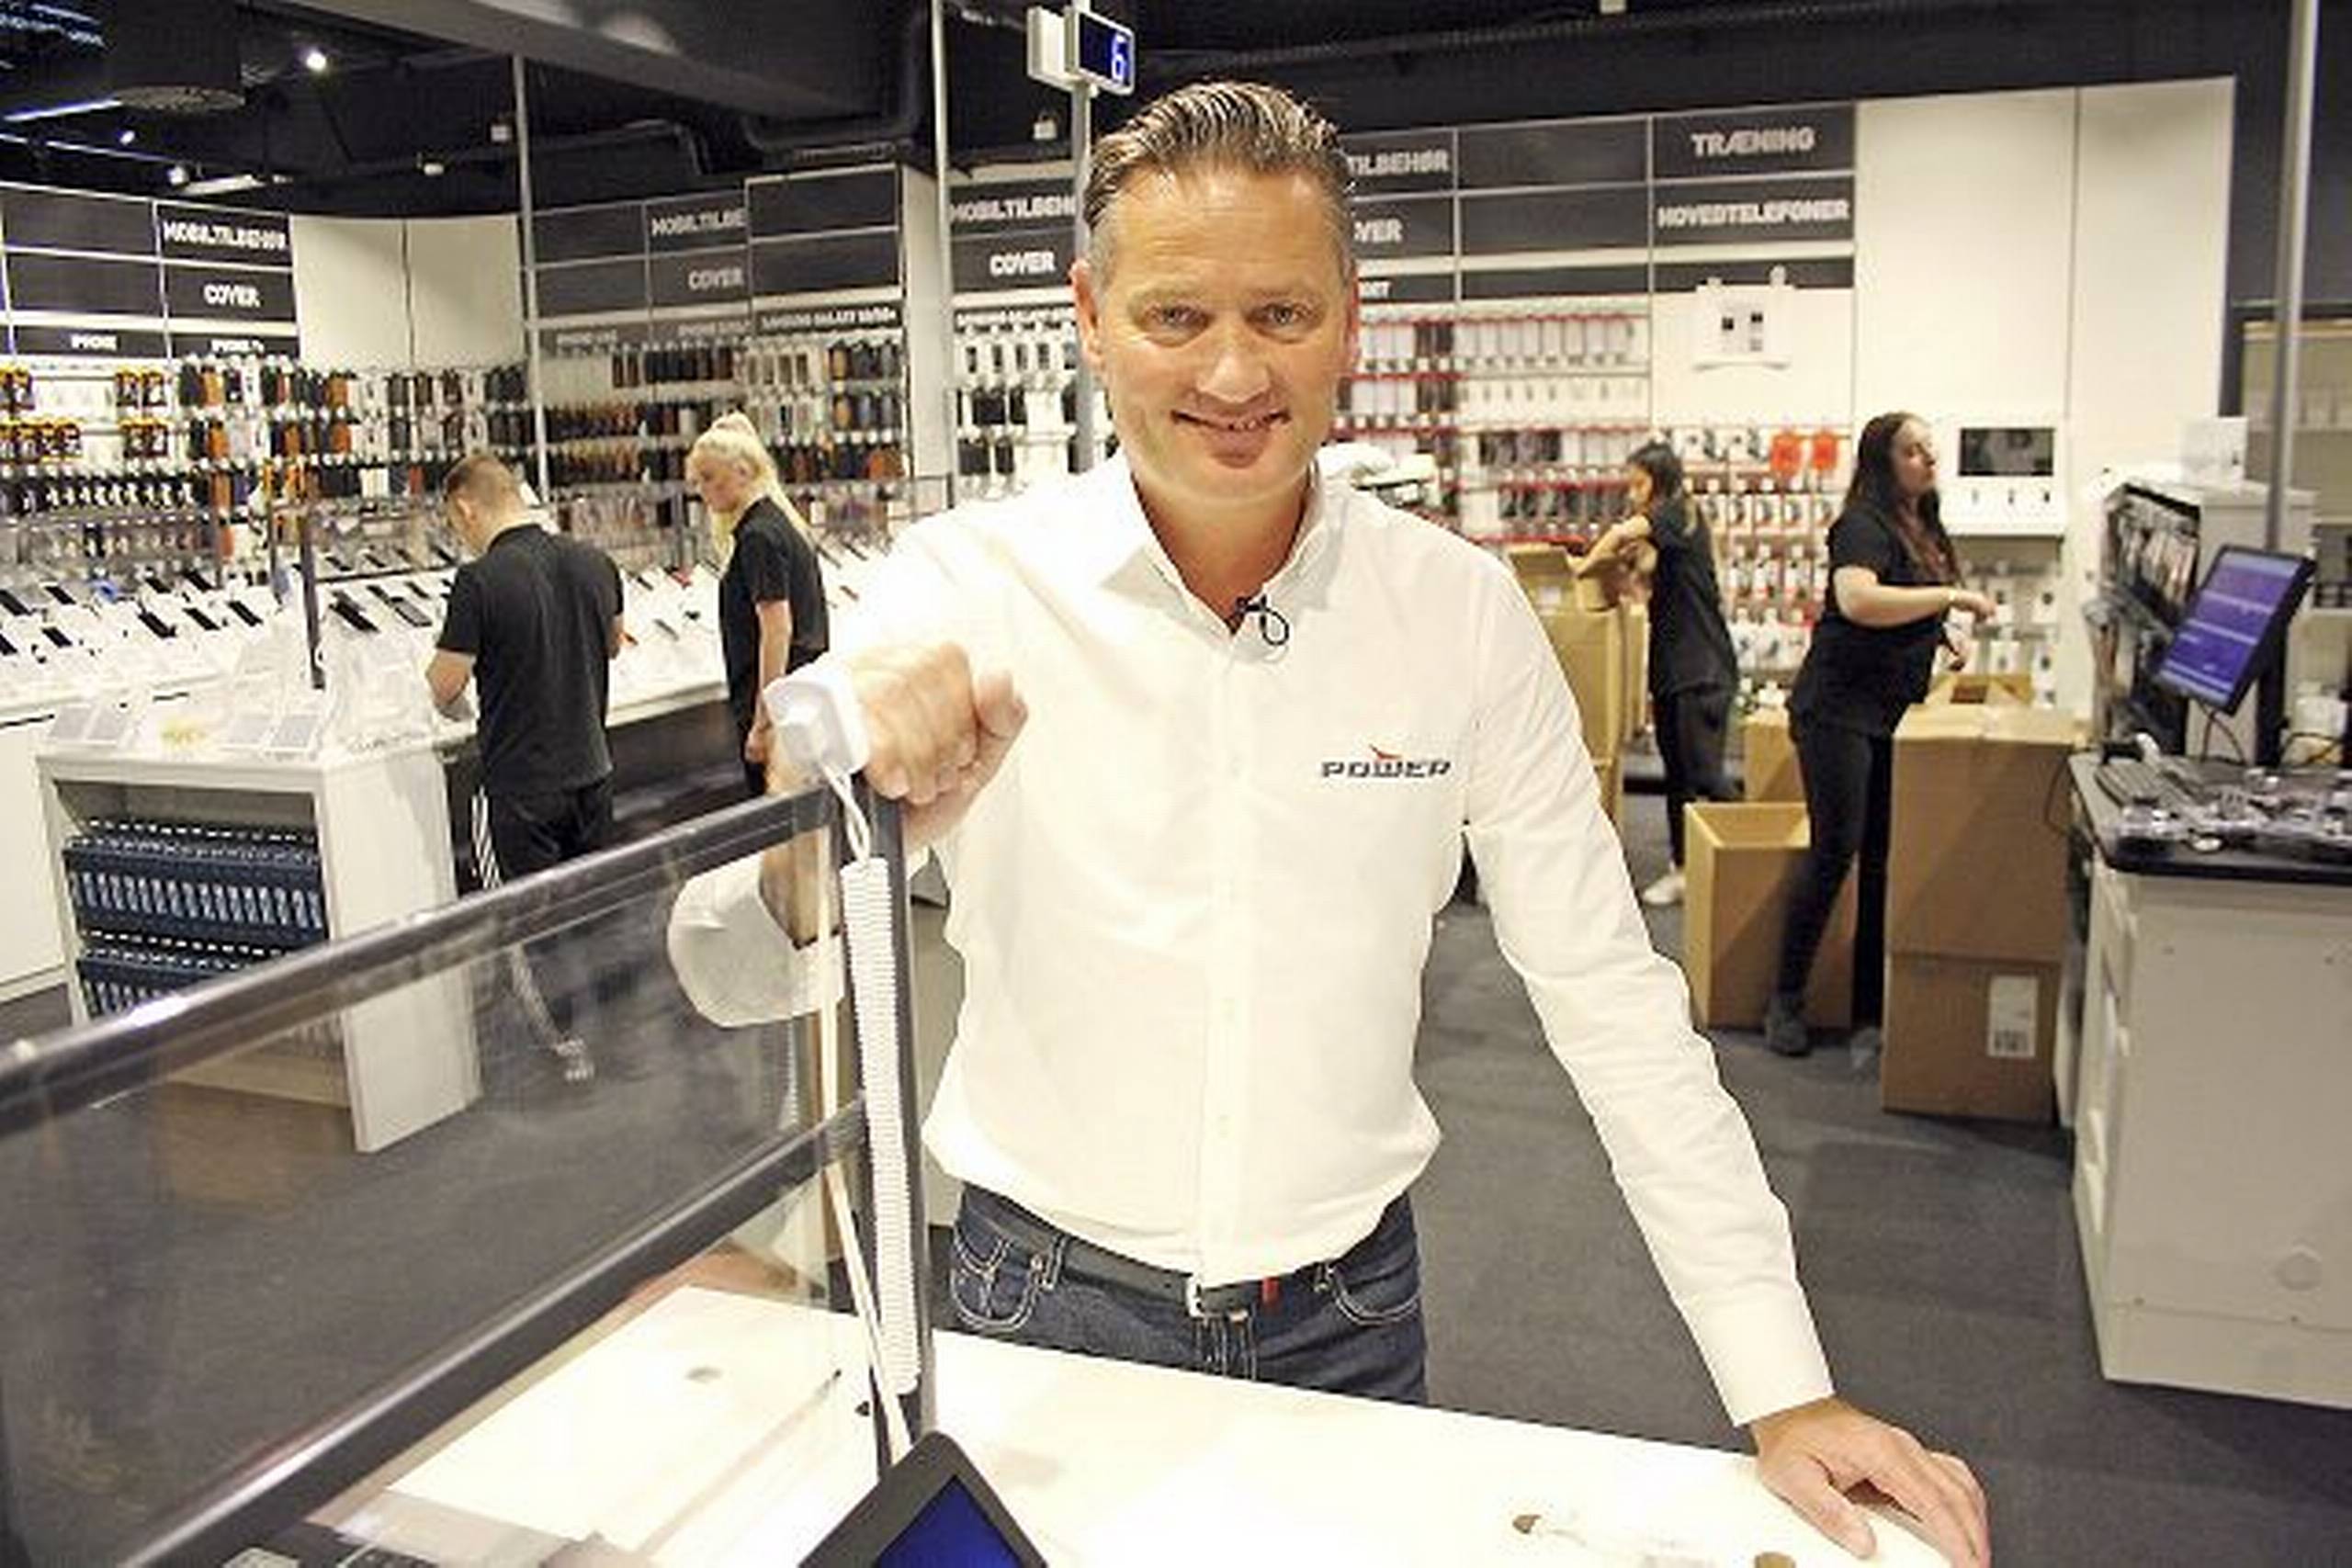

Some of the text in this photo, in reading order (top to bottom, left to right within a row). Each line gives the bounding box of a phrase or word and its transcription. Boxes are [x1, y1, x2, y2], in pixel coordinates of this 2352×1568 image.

[1112, 32, 1127, 82] 6
[1691, 127, 1815, 156] TRÆNING
[1657, 199, 1849, 228] HOVEDTELEFONER
[990, 252, 1056, 276] COVER
[203, 284, 261, 308] COVER
[1321, 761, 1452, 778] POWER
